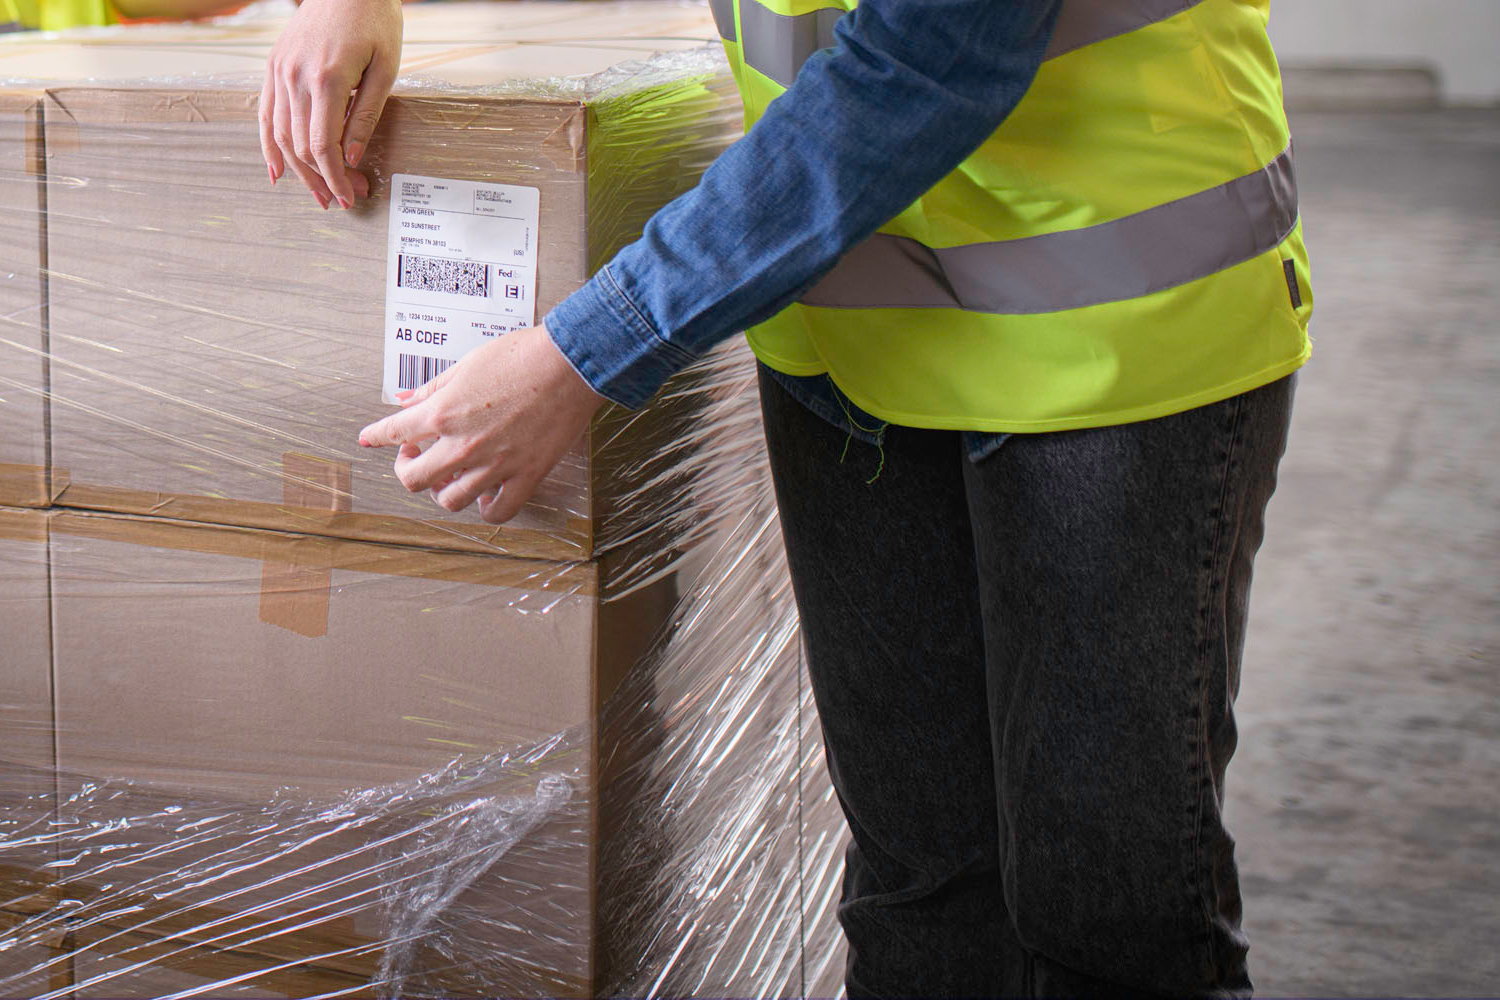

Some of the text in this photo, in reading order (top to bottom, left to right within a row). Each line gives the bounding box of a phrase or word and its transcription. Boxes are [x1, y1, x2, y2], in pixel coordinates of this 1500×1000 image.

[402, 207, 435, 217] JOHN GREEN
[411, 222, 441, 231] SUNSTREET
[401, 236, 424, 245] MEMPHIS
[408, 312, 421, 321] 1234
[421, 314, 434, 322] 1234
[434, 315, 447, 323] 1234
[471, 322, 487, 330] INTL
[395, 327, 448, 346] AB CDEF
